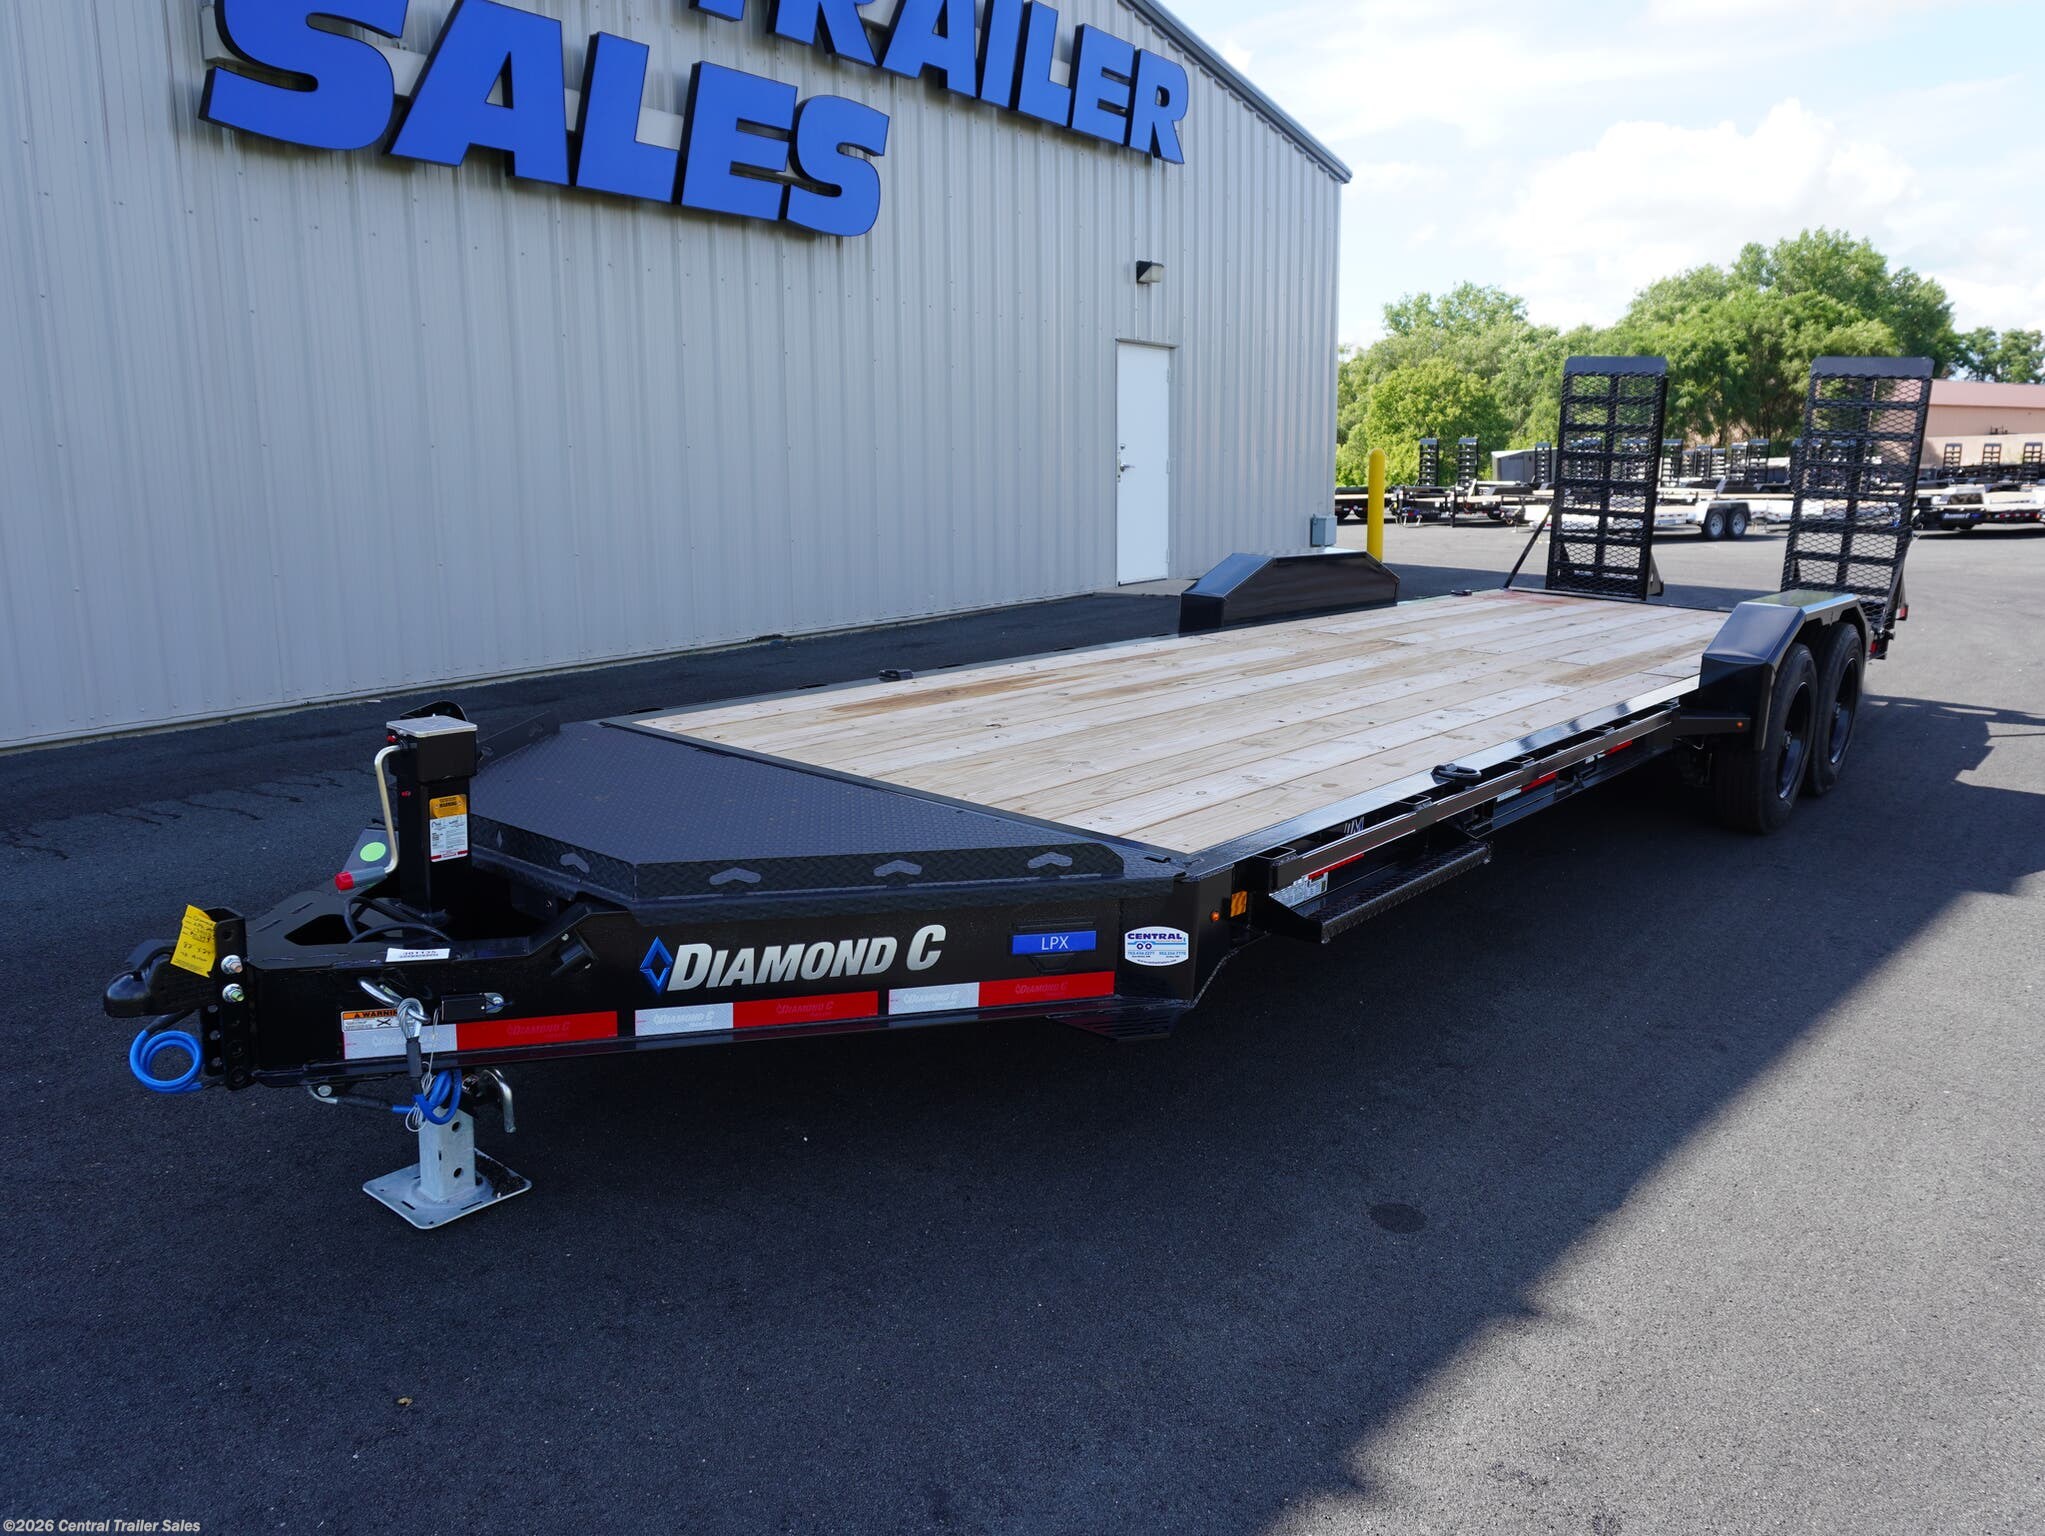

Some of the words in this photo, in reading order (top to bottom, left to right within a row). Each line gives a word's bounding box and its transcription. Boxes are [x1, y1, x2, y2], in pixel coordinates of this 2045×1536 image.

[199, 0, 891, 237] SALES
[666, 936, 898, 992] DIAMOND
[906, 924, 947, 972] C
[1041, 935, 1069, 951] LPX
